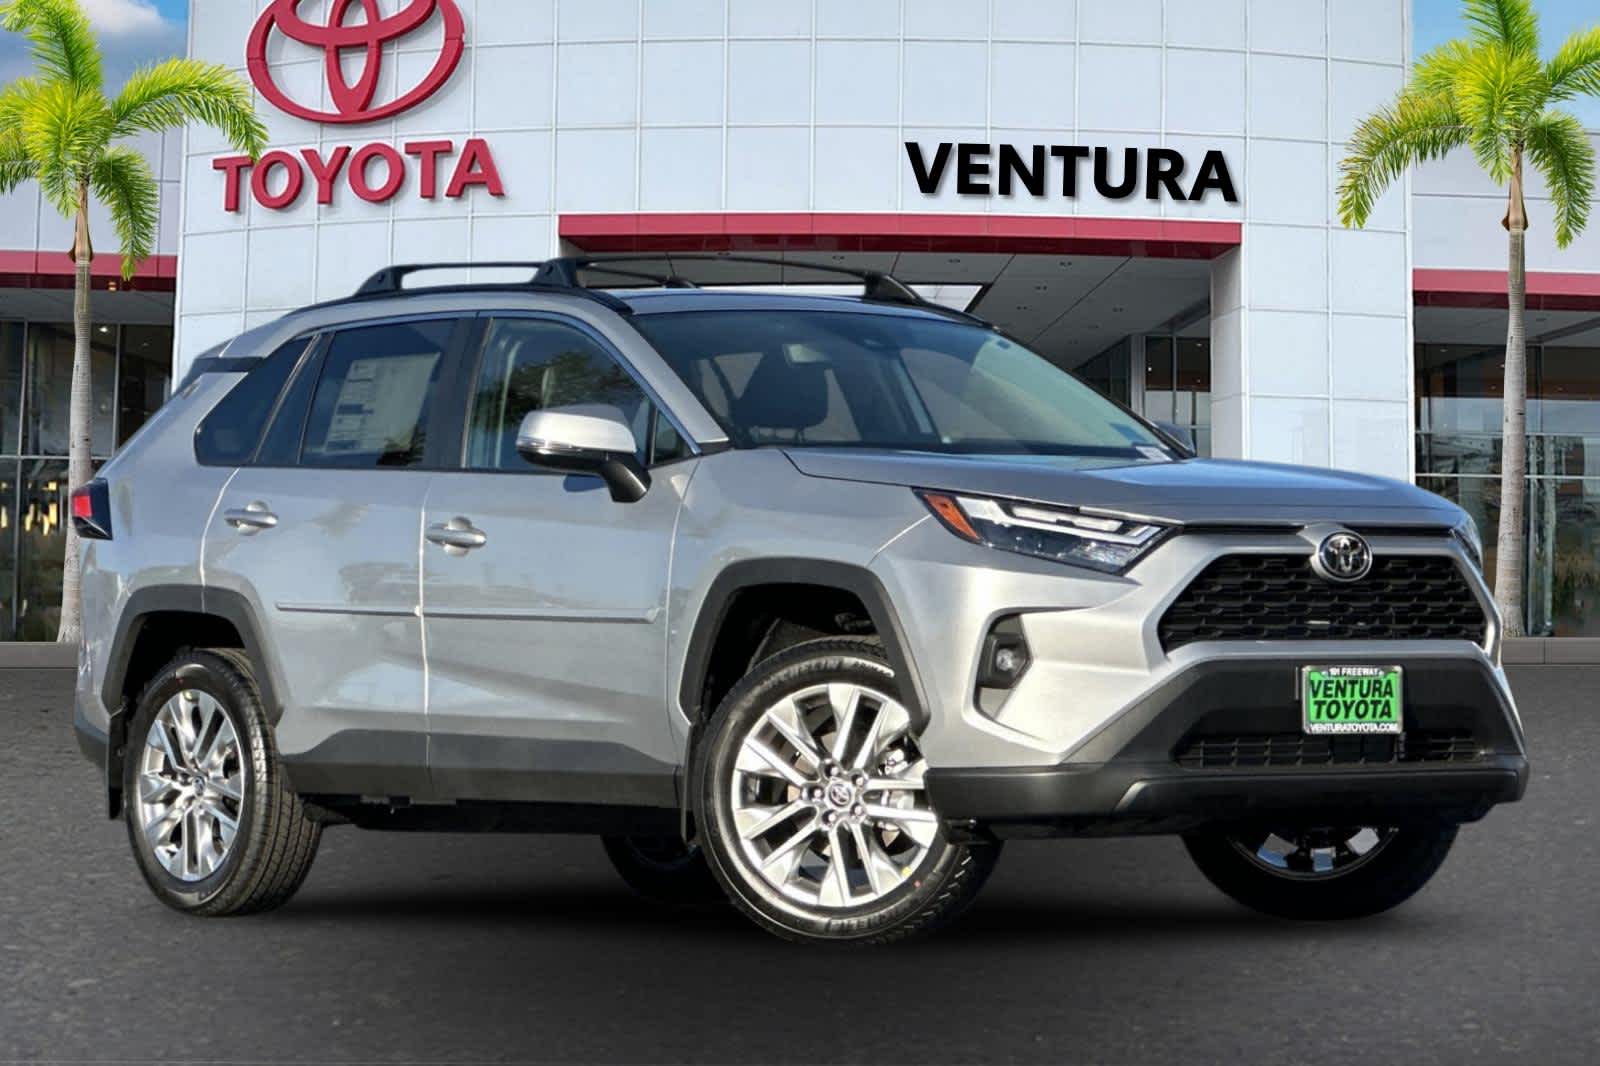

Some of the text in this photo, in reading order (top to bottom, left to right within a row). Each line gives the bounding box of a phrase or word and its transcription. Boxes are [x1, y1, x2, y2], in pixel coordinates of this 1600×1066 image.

[212, 138, 505, 212] TOYOTA
[904, 142, 1239, 203] VENTURA
[1310, 680, 1393, 698] VENTURA
[1313, 700, 1392, 719] TOYOTA
